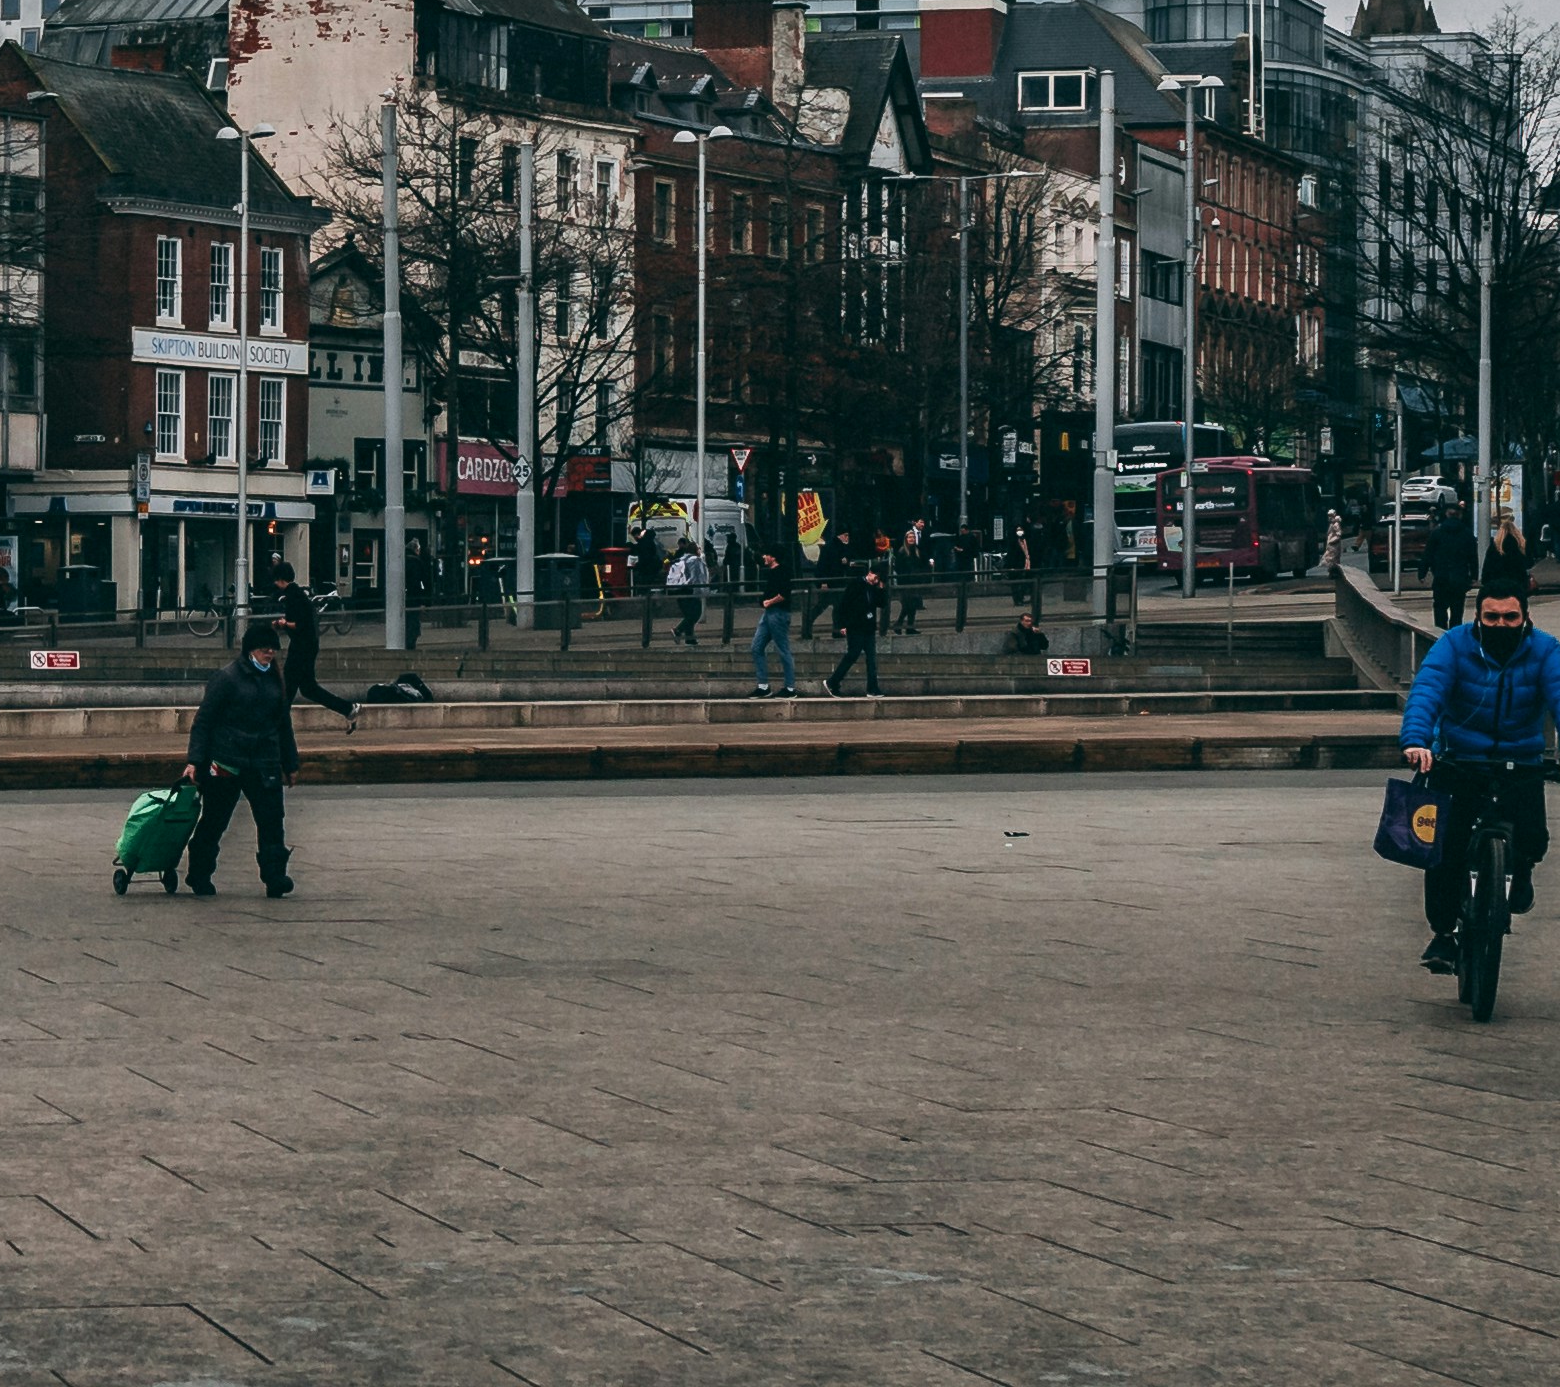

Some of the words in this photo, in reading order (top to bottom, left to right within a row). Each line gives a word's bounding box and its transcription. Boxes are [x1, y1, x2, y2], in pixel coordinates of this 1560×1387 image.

[151, 337, 196, 357] SKIPTON
[197, 341, 241, 360] BUILDIN
[249, 345, 291, 368] SOCIETY
[457, 456, 515, 482] CARDZO
[514, 464, 530, 477] 25
